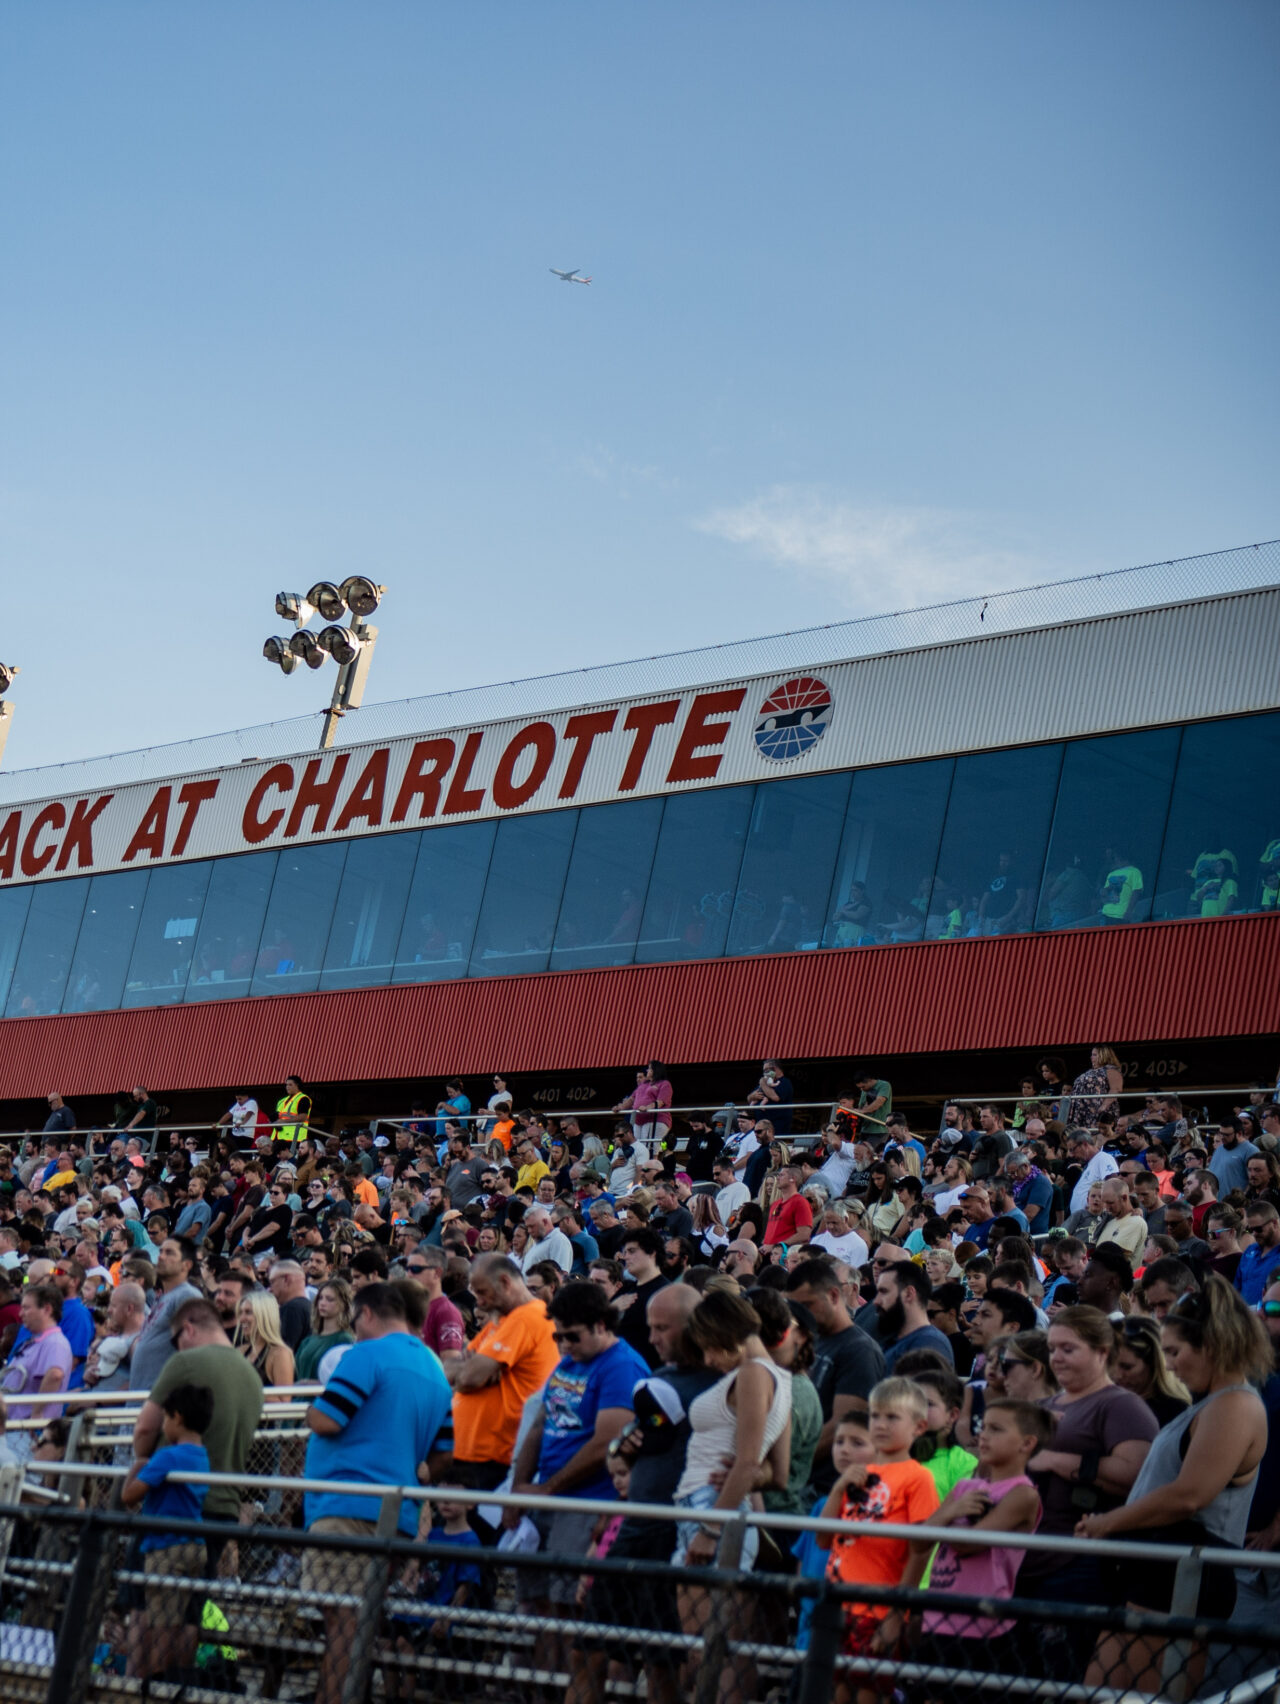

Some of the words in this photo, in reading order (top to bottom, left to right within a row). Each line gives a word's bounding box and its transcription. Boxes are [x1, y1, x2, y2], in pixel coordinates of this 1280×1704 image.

[121, 779, 220, 863] AT
[242, 688, 747, 844] CHARLOTTE
[1145, 1059, 1178, 1077] 403
[539, 1088, 561, 1102] 401
[566, 1086, 590, 1101] 402
